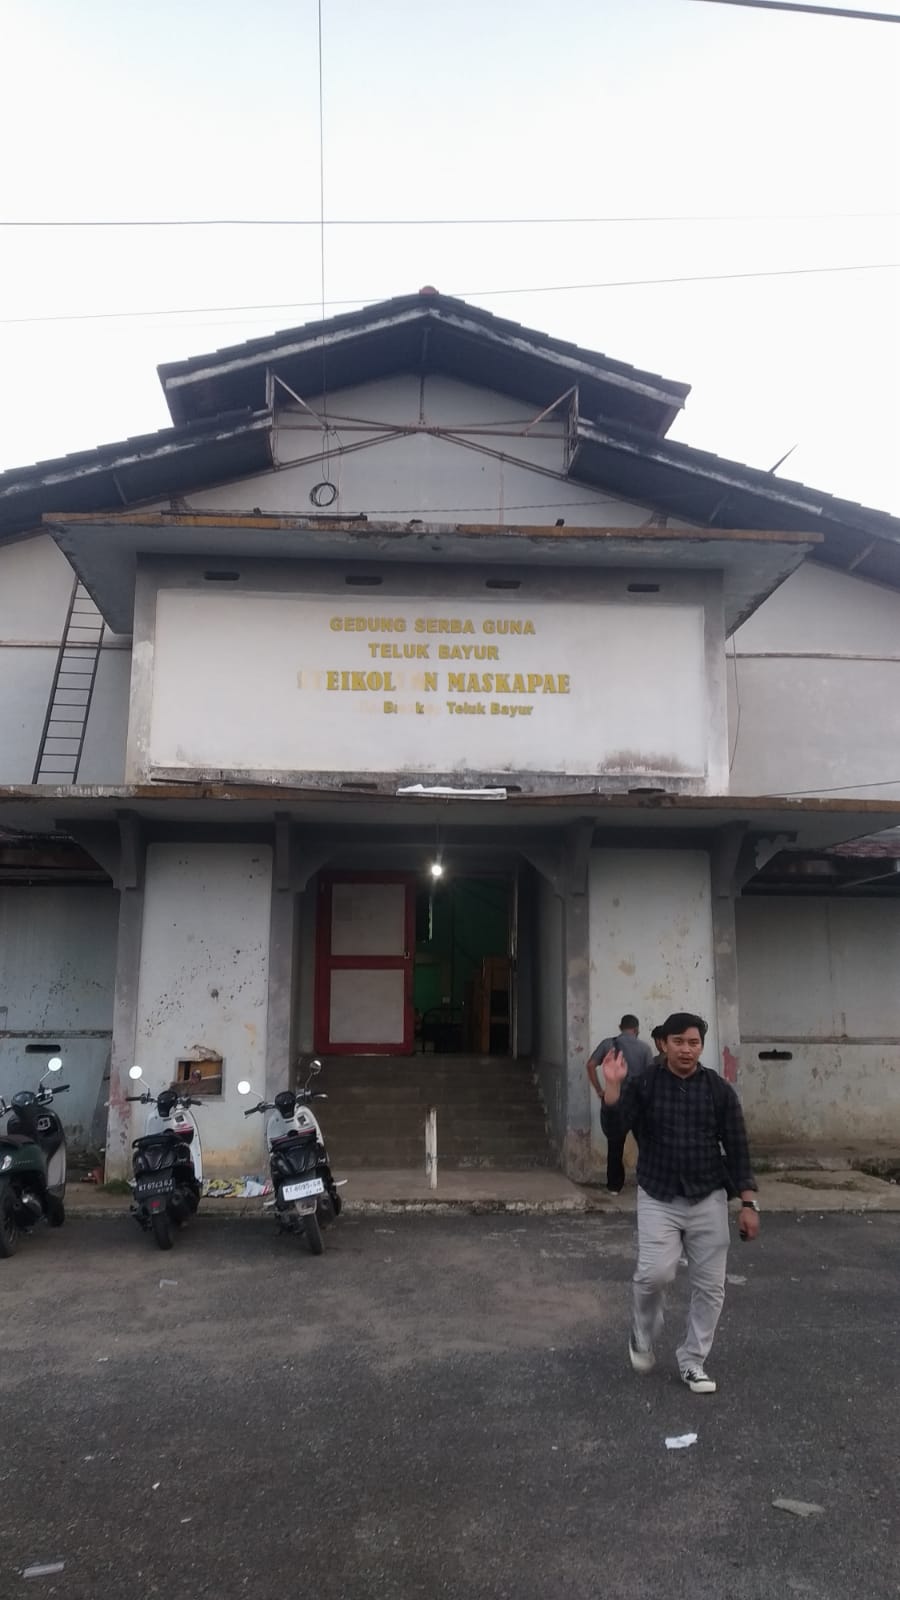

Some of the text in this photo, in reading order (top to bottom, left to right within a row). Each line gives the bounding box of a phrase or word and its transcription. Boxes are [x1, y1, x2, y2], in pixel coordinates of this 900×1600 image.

[329, 616, 536, 635] GEDUNG SERBA GUNA
[368, 642, 500, 660] TELUK BAYUR
[447, 671, 571, 694] MASKAPAE
[447, 701, 486, 715] Teluk
[490, 702, 534, 718] Bayur
